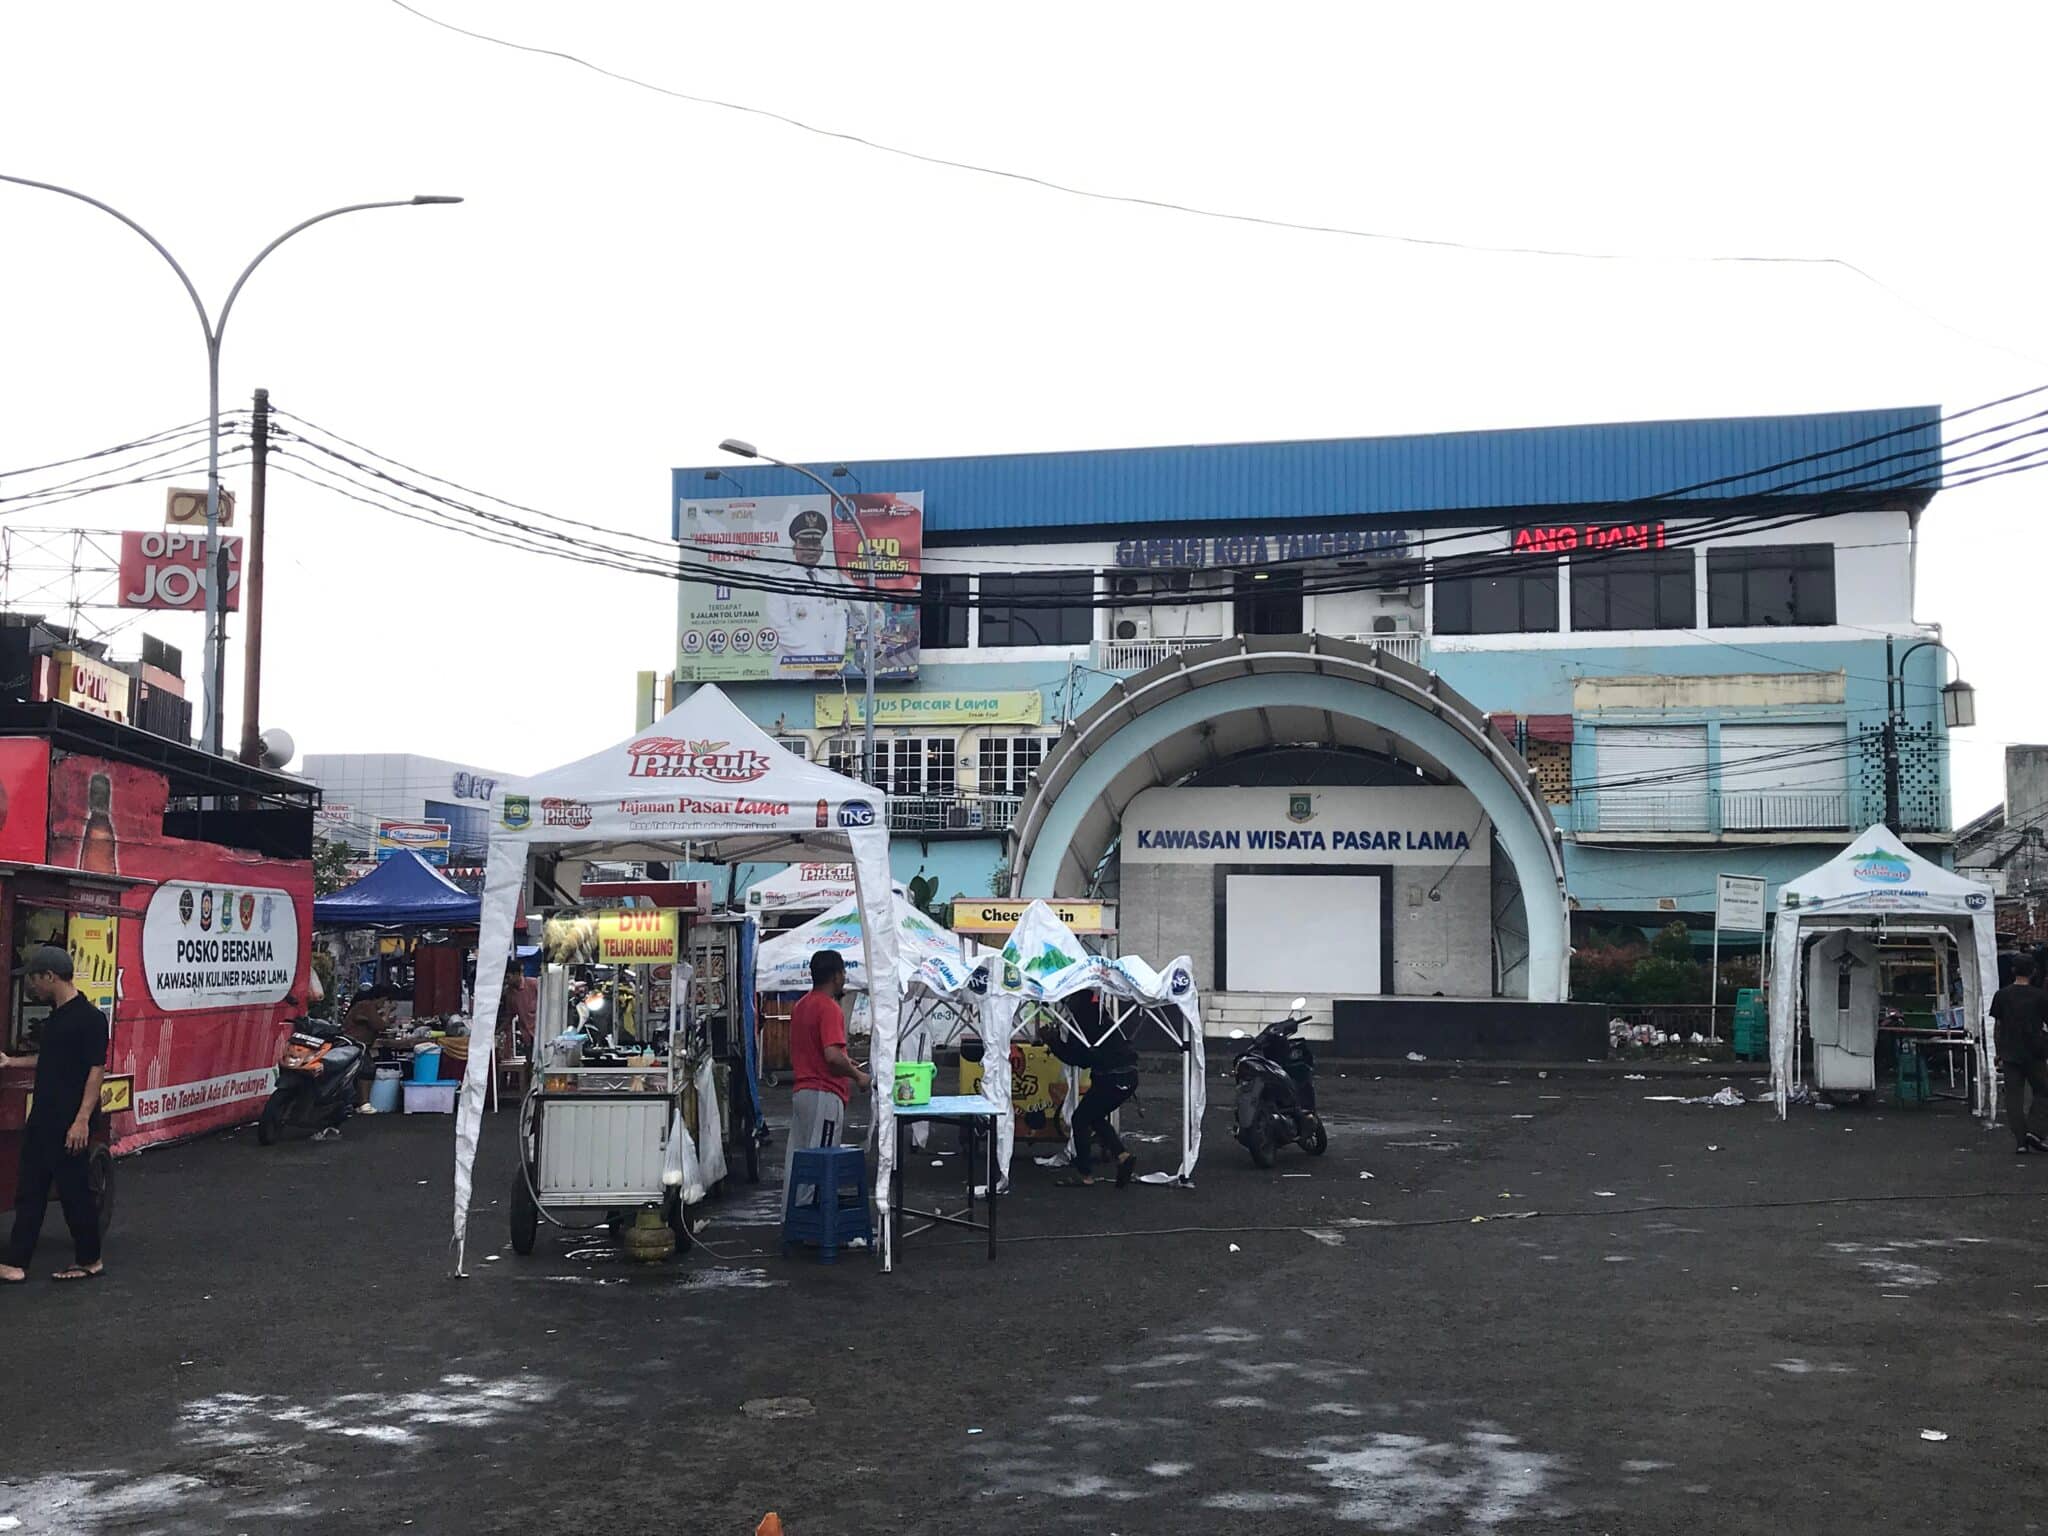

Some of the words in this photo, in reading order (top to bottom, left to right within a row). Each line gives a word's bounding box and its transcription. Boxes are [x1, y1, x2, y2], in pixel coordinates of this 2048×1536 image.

[141, 533, 239, 562] OPTK
[733, 531, 779, 544] INDONESIA
[1214, 536, 1269, 564] KOTA
[1275, 530, 1409, 560] TANGERANG
[689, 634, 697, 644] 0
[710, 633, 725, 643] 40
[735, 632, 750, 643] 60
[760, 631, 775, 642] 90
[75, 665, 109, 703] OPTIK
[656, 767, 750, 778] HARUM
[617, 801, 675, 815] Jajanan
[680, 798, 733, 814] Pasar
[734, 798, 789, 816] Lama
[840, 810, 872, 825] TNG
[1138, 830, 1240, 849] KAWASAN
[1247, 830, 1326, 850] WISATA
[1333, 831, 1401, 850] PASAR
[1406, 831, 1470, 850] LAMA
[619, 911, 661, 932] DWI
[981, 909, 1023, 922] Chee
[177, 940, 219, 963] POSKO
[221, 940, 274, 962] BERSAMA
[604, 938, 634, 957] TELUR
[635, 938, 674, 957] GULUNG
[157, 972, 205, 990] KAWASAN
[205, 971, 240, 987] KULINER
[241, 970, 266, 986] PASAR
[267, 970, 289, 985] LAMA
[138, 1098, 159, 1118] Rasa
[162, 1093, 176, 1112] Teh
[178, 1087, 206, 1108] Terbaik
[206, 1083, 222, 1102] Ada
[222, 1079, 230, 1099] di
[230, 1073, 269, 1096] Pucuknya!
